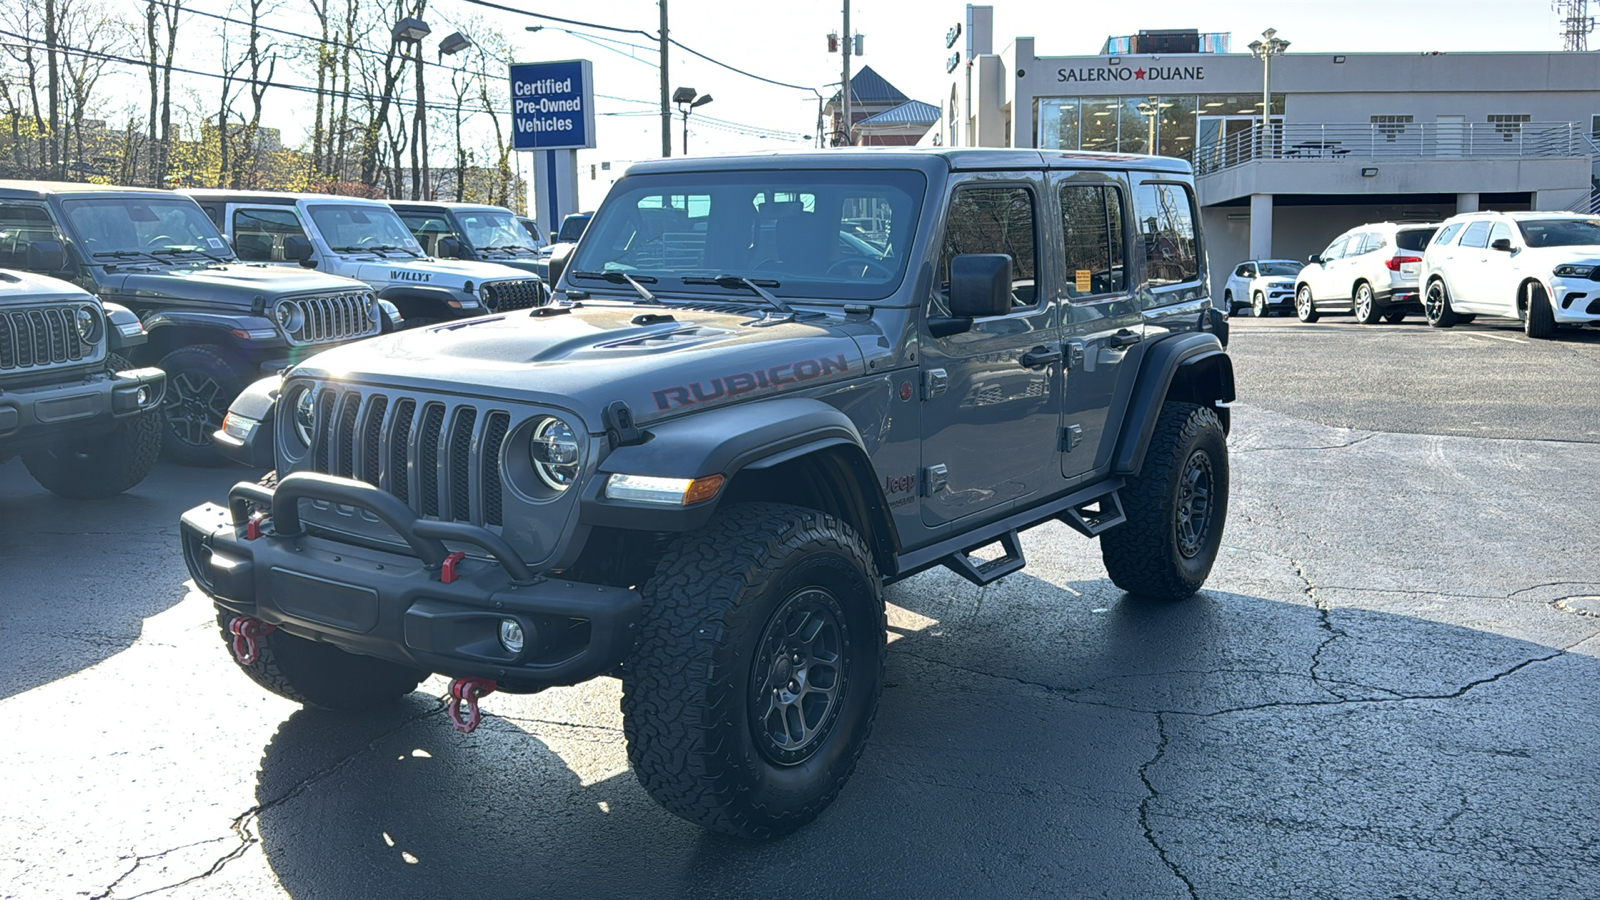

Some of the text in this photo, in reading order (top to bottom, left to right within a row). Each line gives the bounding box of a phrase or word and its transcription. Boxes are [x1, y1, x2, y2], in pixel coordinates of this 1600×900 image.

[1057, 66, 1205, 82] SALERNO DUANE
[515, 77, 572, 95] Certified
[515, 96, 581, 114] Pre-Owned
[517, 116, 573, 133] Vehicles
[390, 270, 432, 282] WILLYS
[652, 354, 849, 410] RUBICON
[883, 473, 915, 495] Jeep
